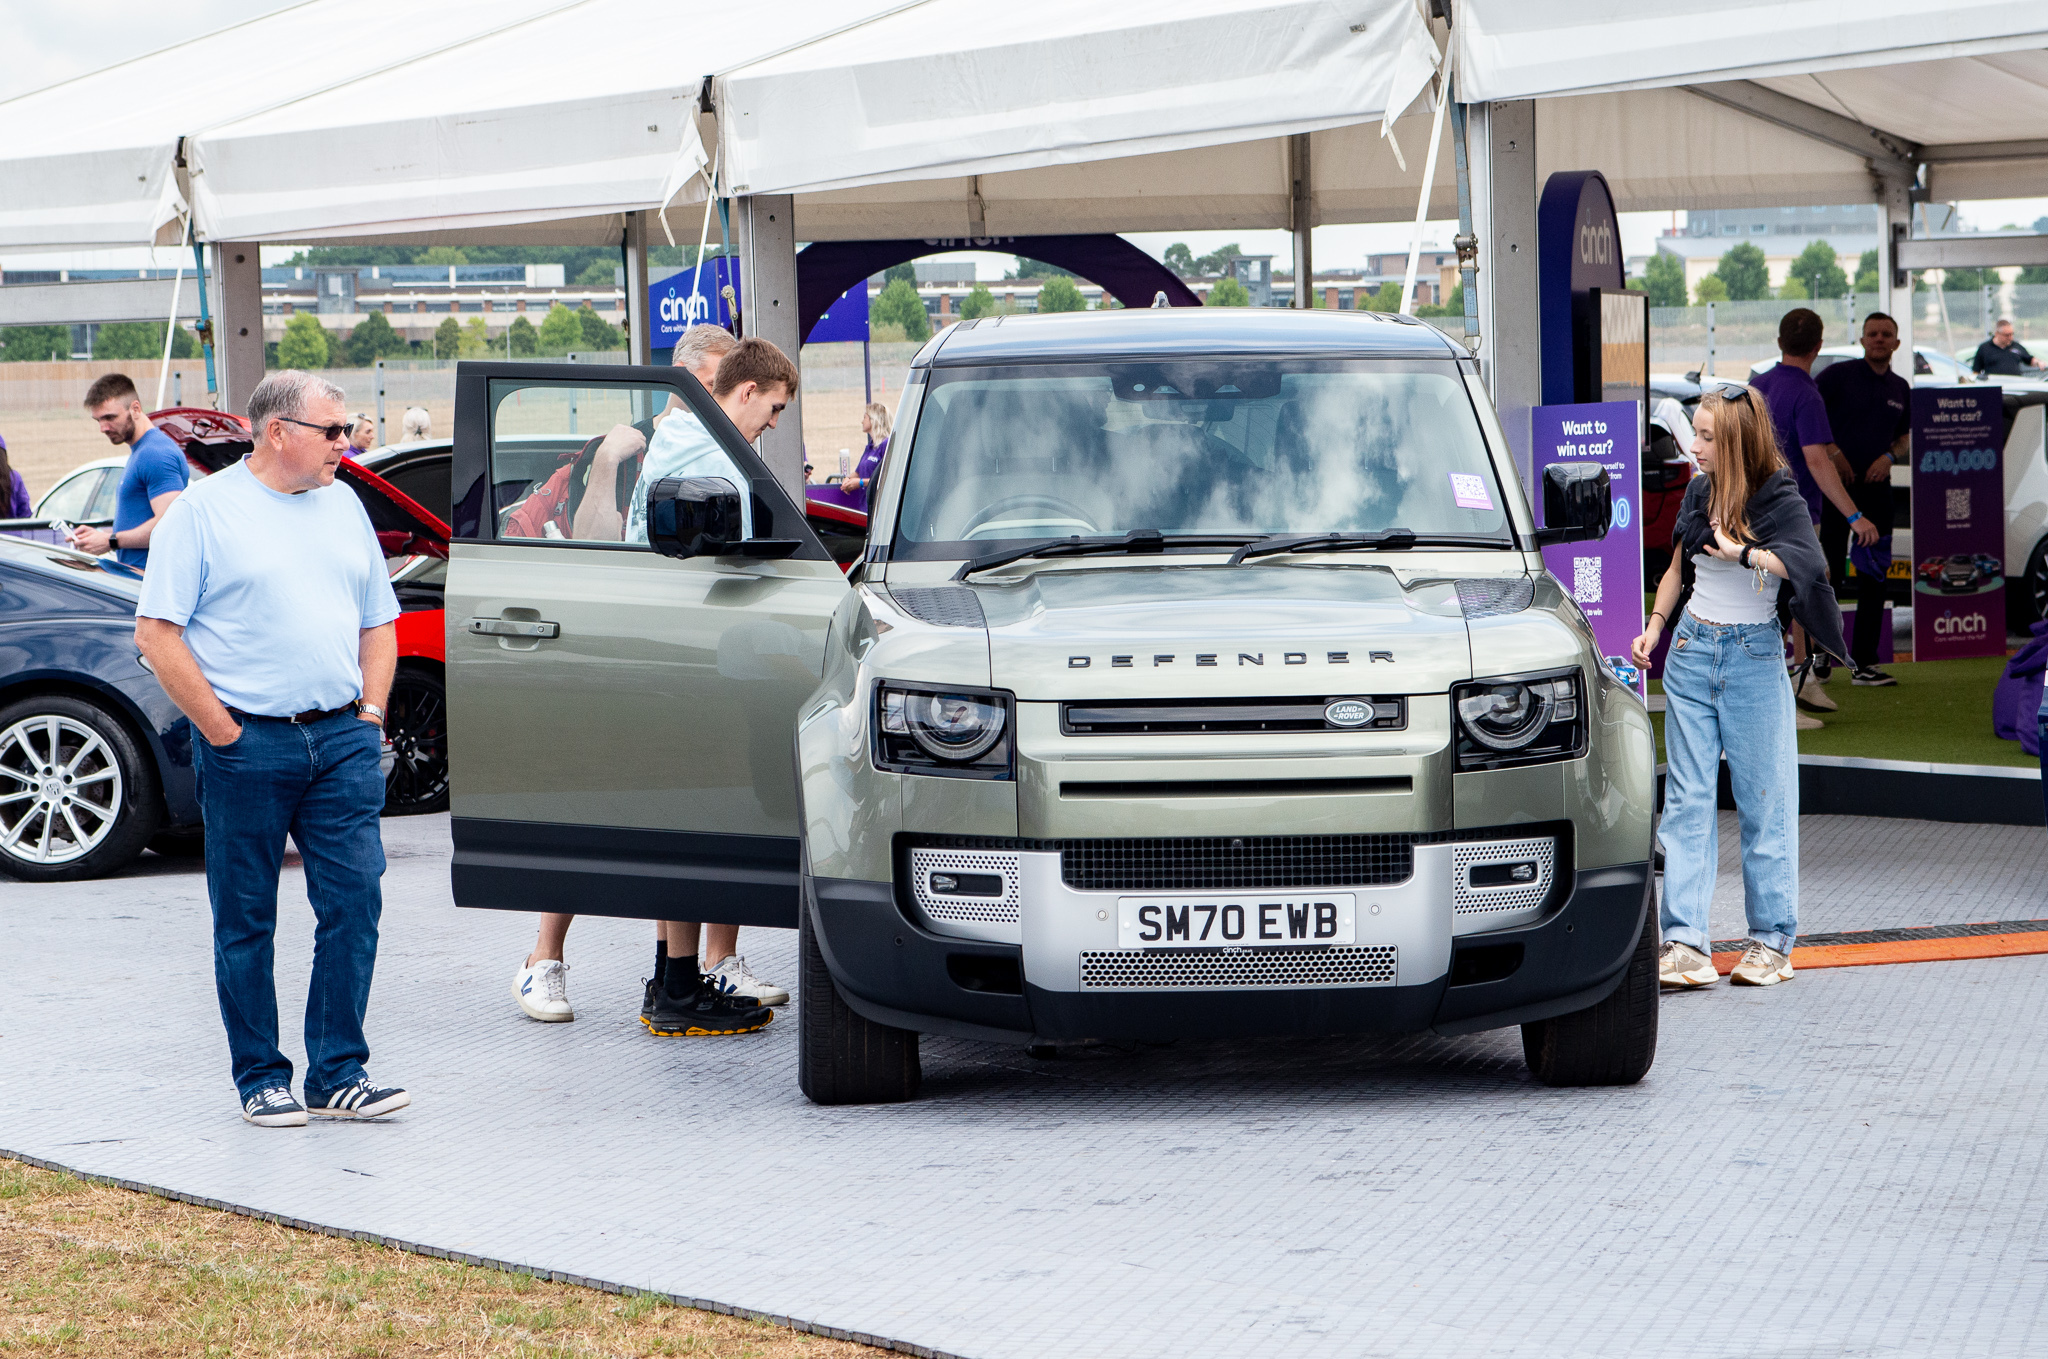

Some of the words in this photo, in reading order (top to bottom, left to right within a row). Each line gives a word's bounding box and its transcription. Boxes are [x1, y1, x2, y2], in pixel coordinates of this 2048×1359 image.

[1580, 208, 1612, 265] cinch
[660, 287, 709, 322] cinch
[1937, 398, 1965, 409] Want
[1965, 398, 1978, 408] to
[1932, 411, 1950, 423] win
[1951, 413, 1960, 422] a
[1960, 410, 1982, 422] car?
[1562, 420, 1593, 436] Want
[1594, 420, 1607, 434] to
[1557, 441, 1576, 457] win
[1578, 444, 1587, 455] a
[1588, 439, 1614, 456] car?
[1920, 448, 1996, 475] £10,000
[1594, 608, 1603, 616] win
[1933, 609, 1987, 634] cinch
[1068, 650, 1395, 668] DEFENDER
[1138, 904, 1245, 942] SM70
[1258, 902, 1337, 940] EWB
